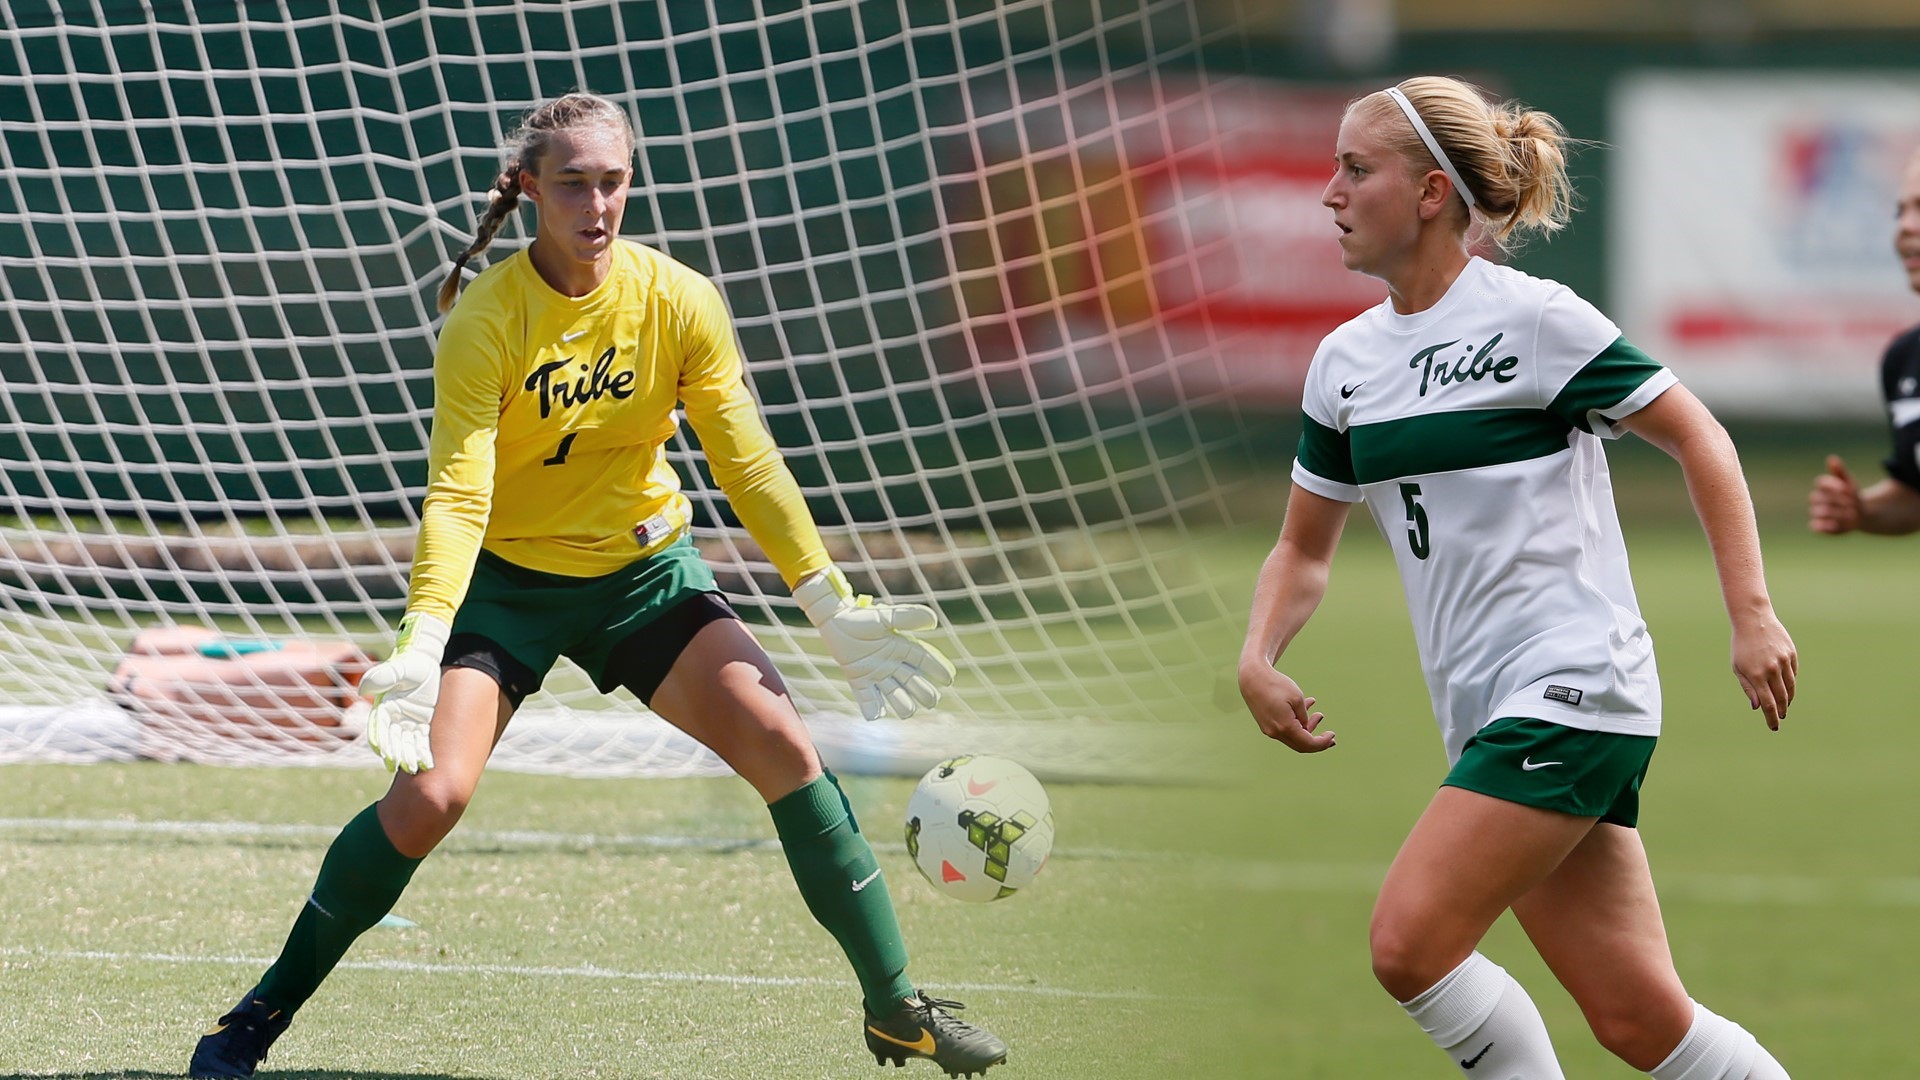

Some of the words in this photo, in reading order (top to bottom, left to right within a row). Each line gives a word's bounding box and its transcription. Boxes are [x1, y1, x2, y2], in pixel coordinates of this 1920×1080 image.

[525, 346, 635, 419] Tribe
[1409, 332, 1519, 397] Tribe
[1399, 482, 1430, 560] 5
